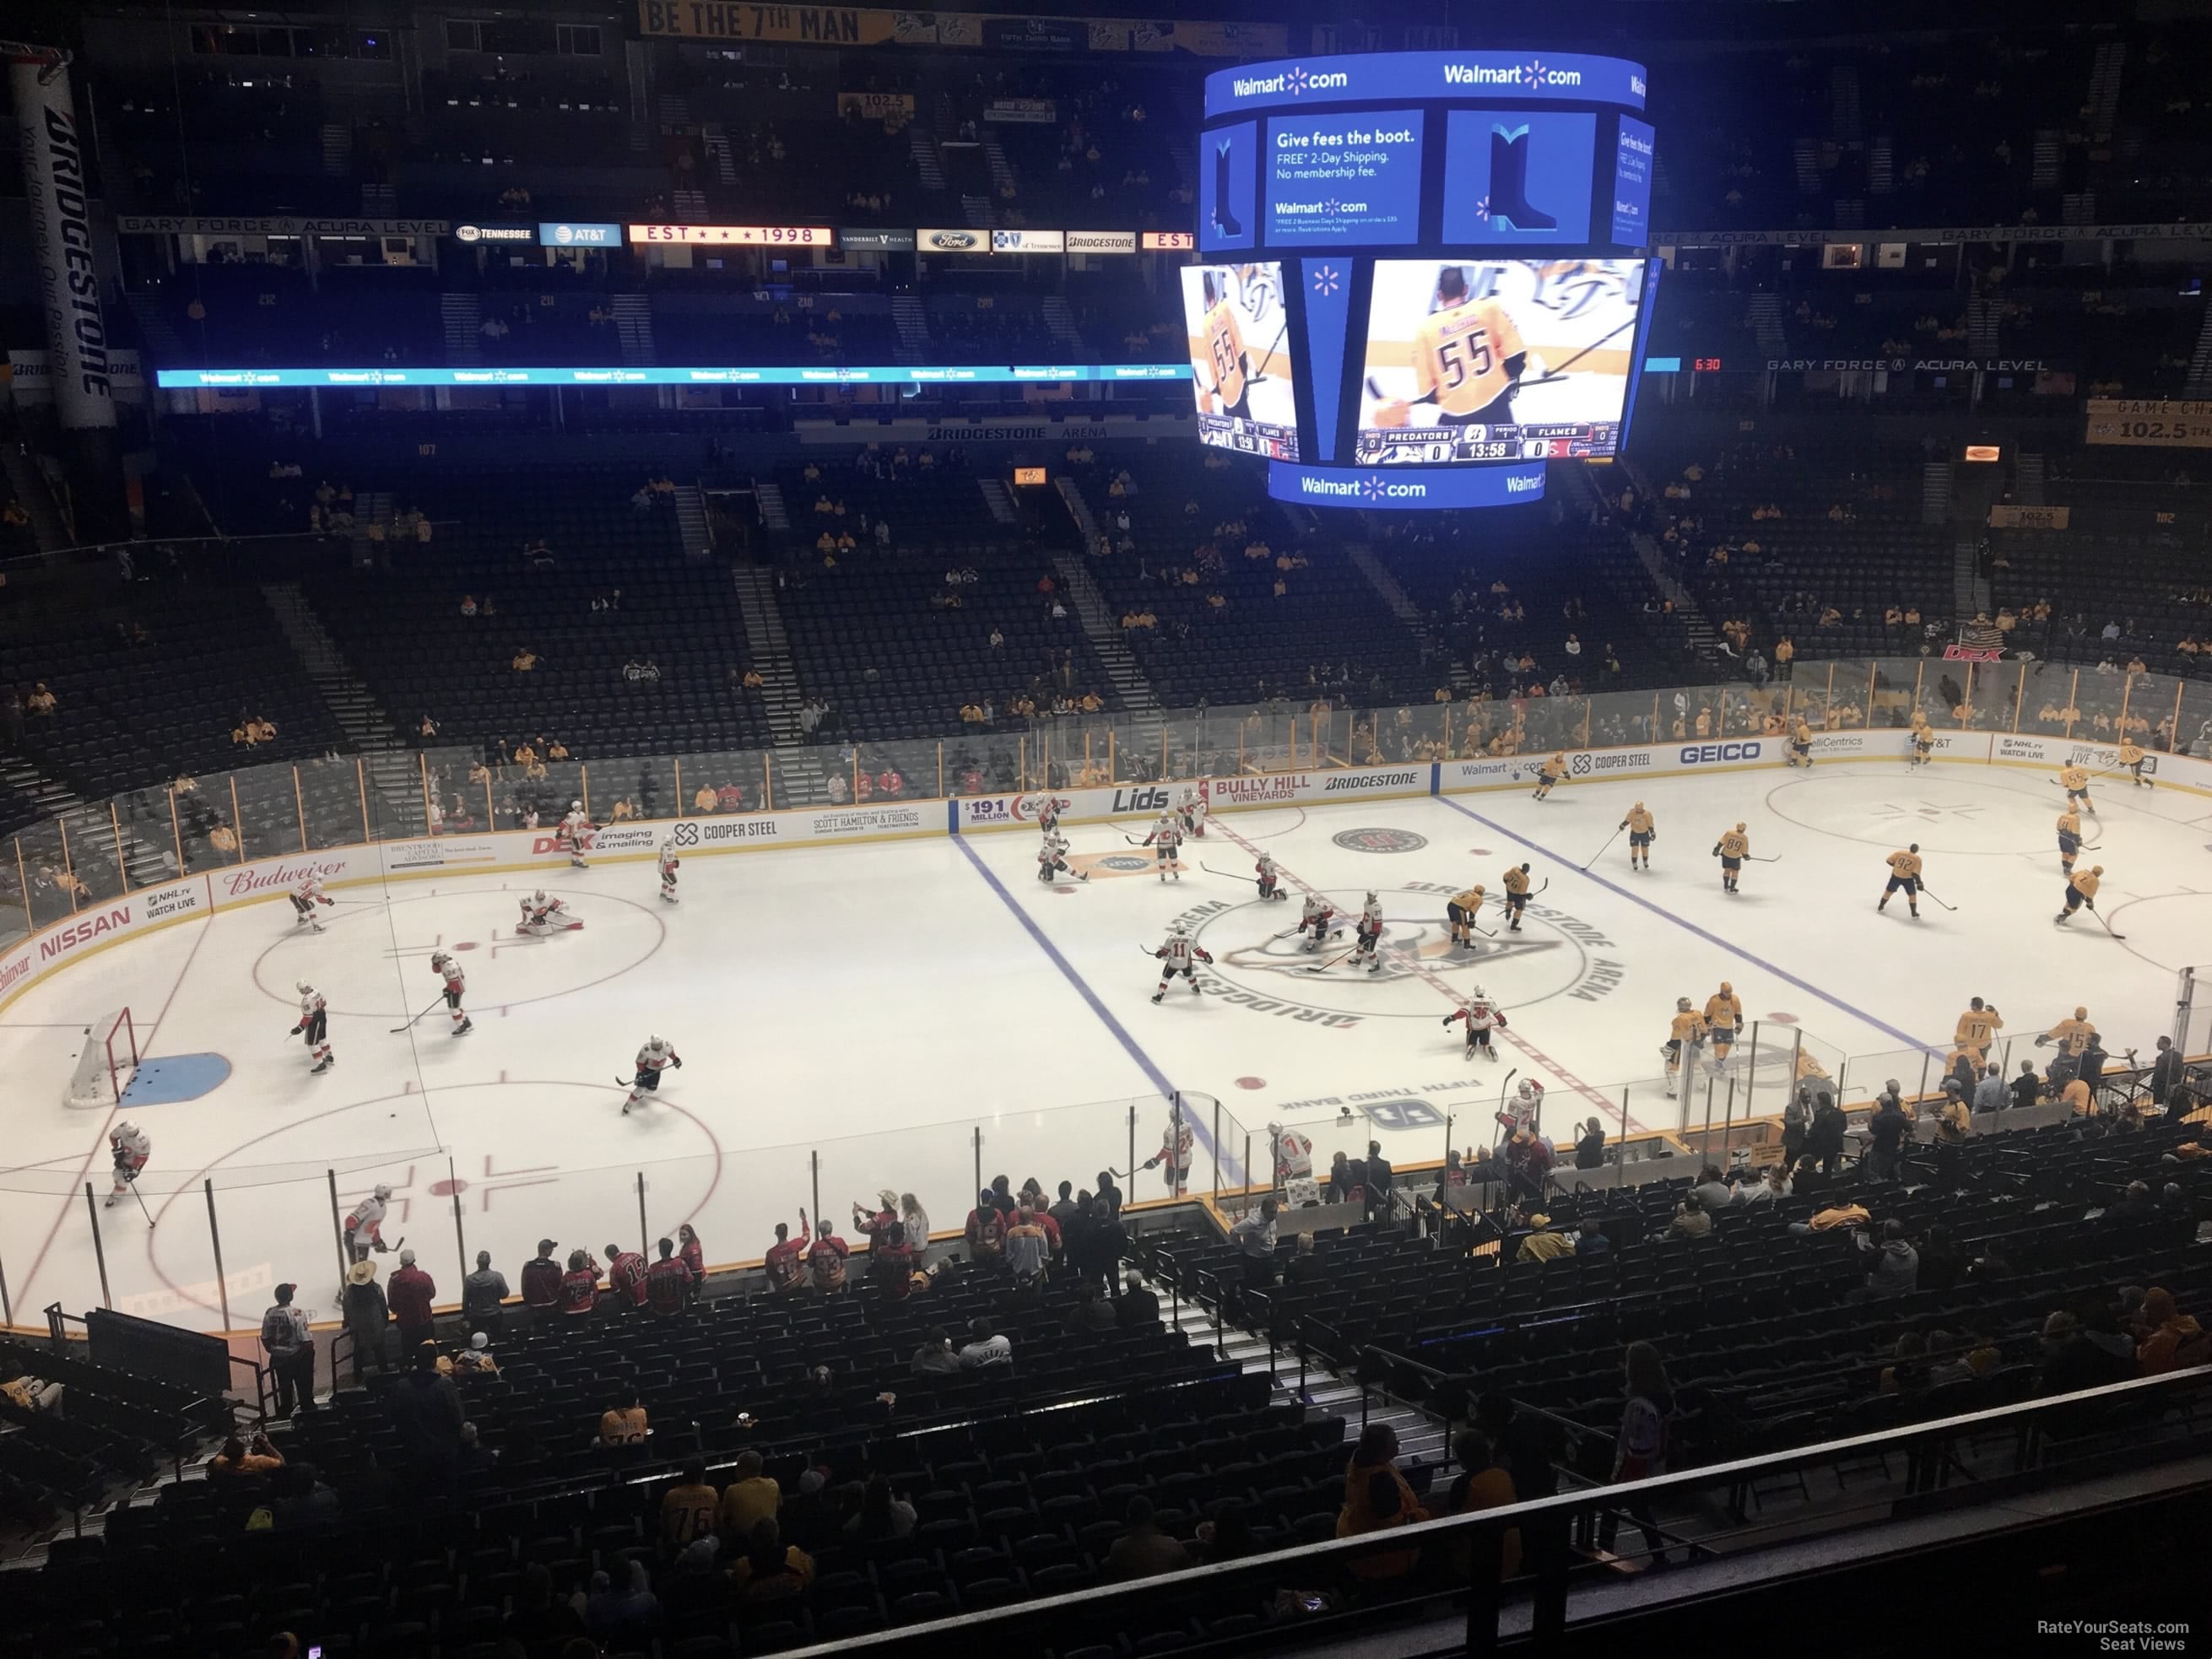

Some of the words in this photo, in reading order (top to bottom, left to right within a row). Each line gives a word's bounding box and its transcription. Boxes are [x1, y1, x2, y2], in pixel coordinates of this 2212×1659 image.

[647, 2, 680, 33] BE
[691, 4, 743, 35] THE
[800, 9, 859, 41] MAN
[1444, 65, 1522, 84] Walmart
[1234, 73, 1284, 97] Walmart
[865, 94, 904, 106] 102.5
[1277, 132, 1309, 149] Give
[1313, 131, 1343, 146] fees
[1348, 130, 1371, 144] the
[1375, 128, 1415, 143] boot.
[1311, 152, 1341, 166] 2-Day
[1344, 151, 1389, 165] Shipping.
[1277, 169, 1292, 180] No
[1294, 167, 1355, 180] membership
[1358, 166, 1377, 177] fee.
[1275, 202, 1322, 215] Walmart
[125, 219, 187, 231] GARY
[197, 219, 273, 232] FORCE
[302, 220, 376, 233] ACURA
[383, 221, 449, 234] LEVEL
[480, 228, 532, 240] TENNESSEE
[1942, 230, 1993, 240] GARY
[2002, 228, 2068, 240] FORCE
[2096, 226, 2161, 237] ACURA
[575, 229, 606, 242] AT&T
[647, 226, 689, 241] EST
[761, 229, 814, 243] 1998
[938, 233, 970, 248] Ford
[1158, 234, 1195, 247] EST
[1710, 233, 1769, 243] ACURA
[1776, 232, 1831, 242] LEVEL
[1030, 241, 1063, 251] Tennessee
[1068, 236, 1134, 249] BRIDGESTONE
[44, 103, 112, 399] BRIDGESTONE
[1213, 329, 1236, 381] 55
[1437, 329, 1492, 389] 55
[1695, 358, 1721, 371] 6:30
[1767, 359, 1817, 370] GARY
[1823, 359, 1886, 370] FORCE
[1914, 359, 1978, 371] ACURA
[1986, 360, 2048, 372] LEVEL
[2117, 401, 2170, 414] GAME
[928, 426, 1047, 440] BRIDGESTONE
[1062, 426, 1107, 438] ARENA
[1388, 430, 1449, 441] PREDATORS
[1539, 427, 1577, 437] FLAMES
[1599, 431, 1606, 440] 0
[2119, 421, 2188, 439] 102.5
[418, 444, 436, 456] 107
[1369, 440, 1376, 449] 0
[1469, 443, 1506, 457] 13:58
[1533, 440, 1543, 457] 0
[1432, 445, 1441, 461] 0
[1301, 476, 1360, 496] Walmart
[2020, 511, 2053, 521] 102.5
[1680, 742, 1761, 765] GEICO
[1999, 748, 2026, 758] WATCH
[2028, 750, 2045, 759] LIVE
[2071, 752, 2092, 765] LIVE
[1462, 762, 1507, 776] Walmart
[1595, 755, 1627, 770] COOPER
[1629, 753, 1651, 767] STEEL
[1216, 777, 1270, 796] BULLY
[1273, 774, 1311, 790] HILL
[1324, 771, 1418, 792] BRIDGESTONE
[2068, 774, 2084, 785] 55
[1111, 786, 1170, 813] Lids
[1230, 788, 1295, 803] VINEYARDS
[971, 799, 1004, 814] 191
[814, 818, 838, 830] SCOTT
[841, 815, 879, 827] HAMILTON
[879, 815, 886, 824] &
[888, 812, 919, 823] FRIENDS
[971, 812, 1009, 822] MILLION
[601, 830, 652, 841] imaging
[704, 822, 746, 840] COOPER
[748, 820, 777, 835] STEEL
[596, 840, 606, 849] &
[608, 838, 654, 850] mailing
[1726, 837, 1743, 852] 89
[1896, 857, 1913, 871] 92
[223, 859, 347, 896] Budweiser
[146, 903, 176, 919] WATCH
[177, 897, 197, 911] LIVE
[40, 906, 132, 961] NISSAN
[1173, 942, 1186, 958] 11
[1567, 958, 1625, 1002] ARENA
[1971, 1023, 1986, 1040] 17
[1421, 1078, 1485, 1093] FIFTH
[1347, 1086, 1420, 1102] THIRD
[1277, 1096, 1344, 1111] BANK
[625, 1256, 648, 1287] 12
